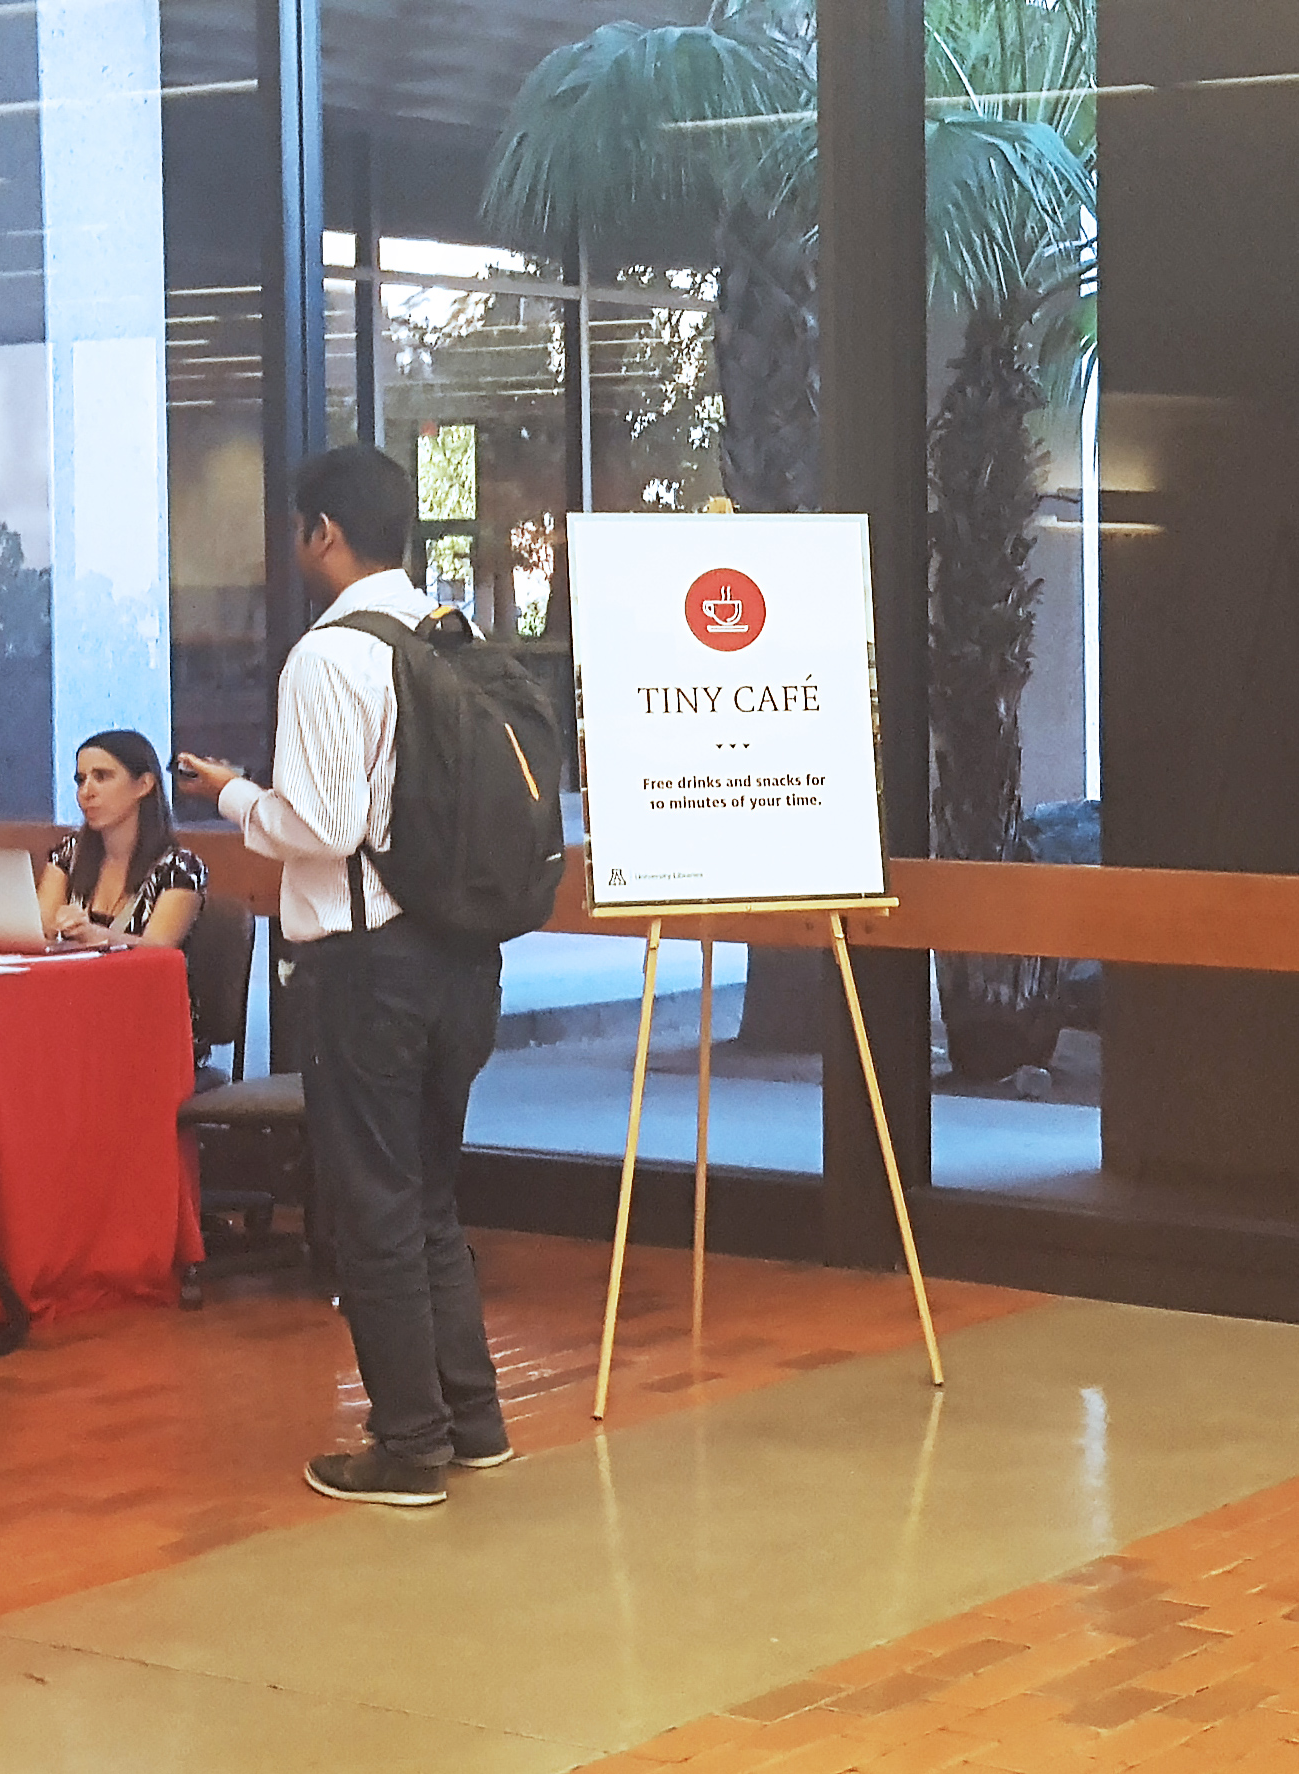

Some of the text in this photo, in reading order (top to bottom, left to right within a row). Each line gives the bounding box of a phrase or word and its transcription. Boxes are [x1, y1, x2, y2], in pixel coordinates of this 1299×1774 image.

[637, 673, 820, 714] TINY CAFÉ
[643, 773, 826, 790] Free drinks and snacks for
[650, 793, 823, 811] 10 minutes of your time.
